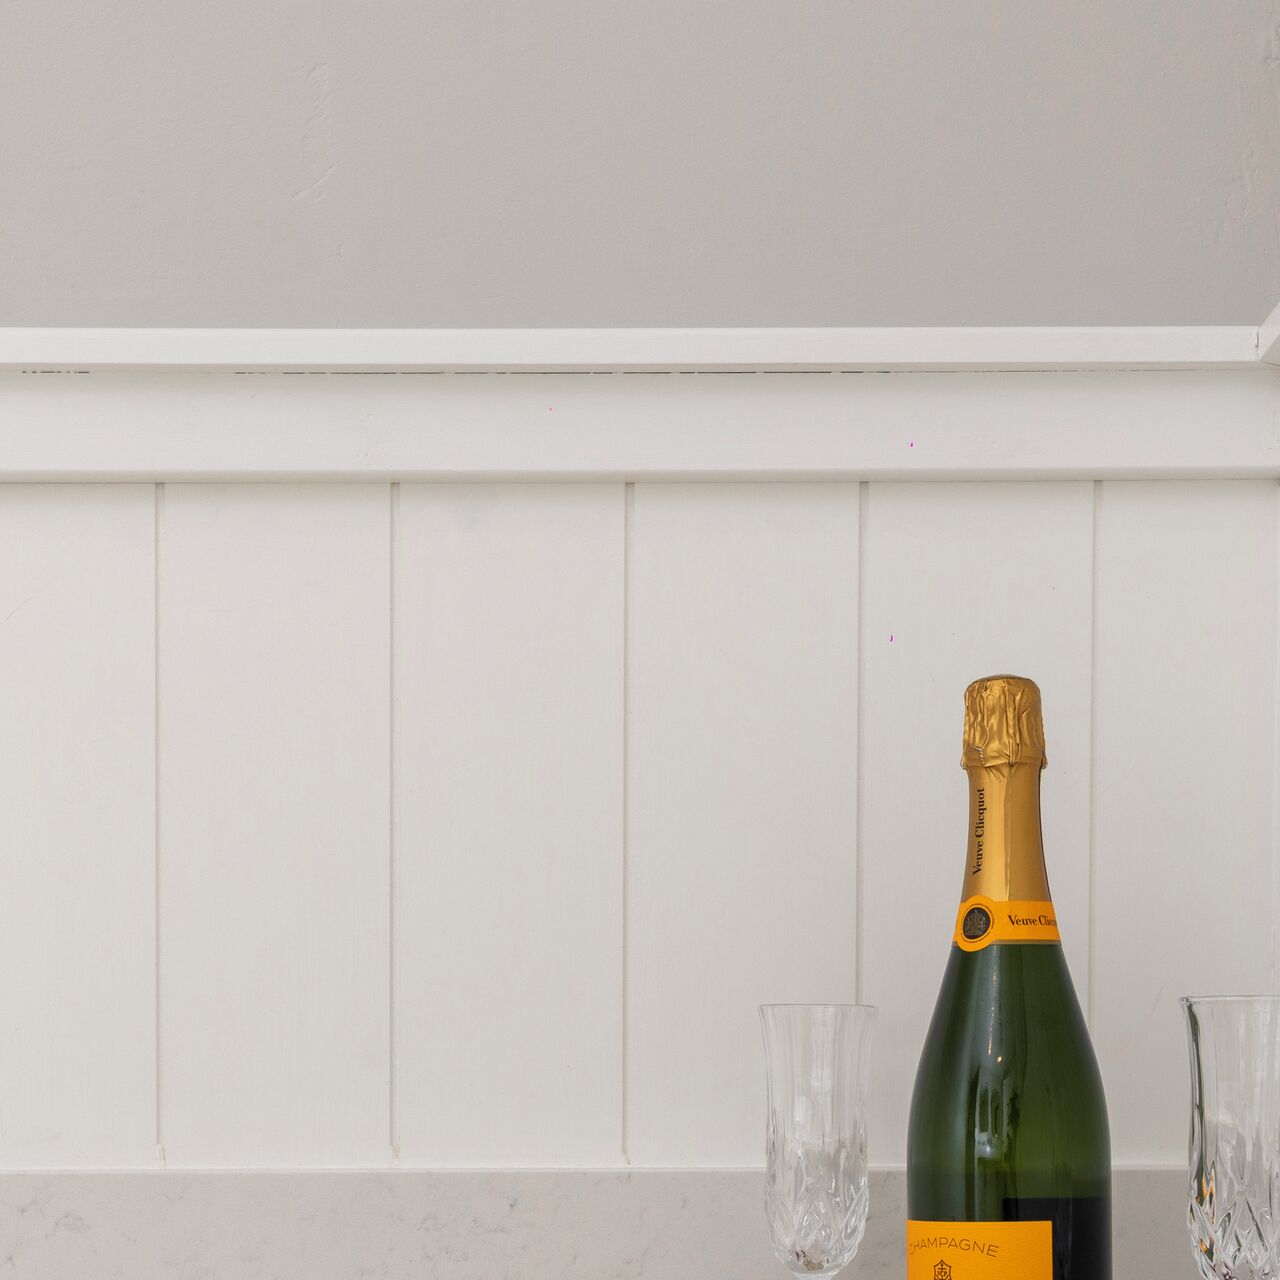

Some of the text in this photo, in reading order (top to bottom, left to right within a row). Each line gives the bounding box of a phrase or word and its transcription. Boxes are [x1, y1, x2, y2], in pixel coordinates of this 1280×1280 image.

[972, 787, 987, 876] Veuve Clicquot
[1008, 914, 1037, 926] Veuve
